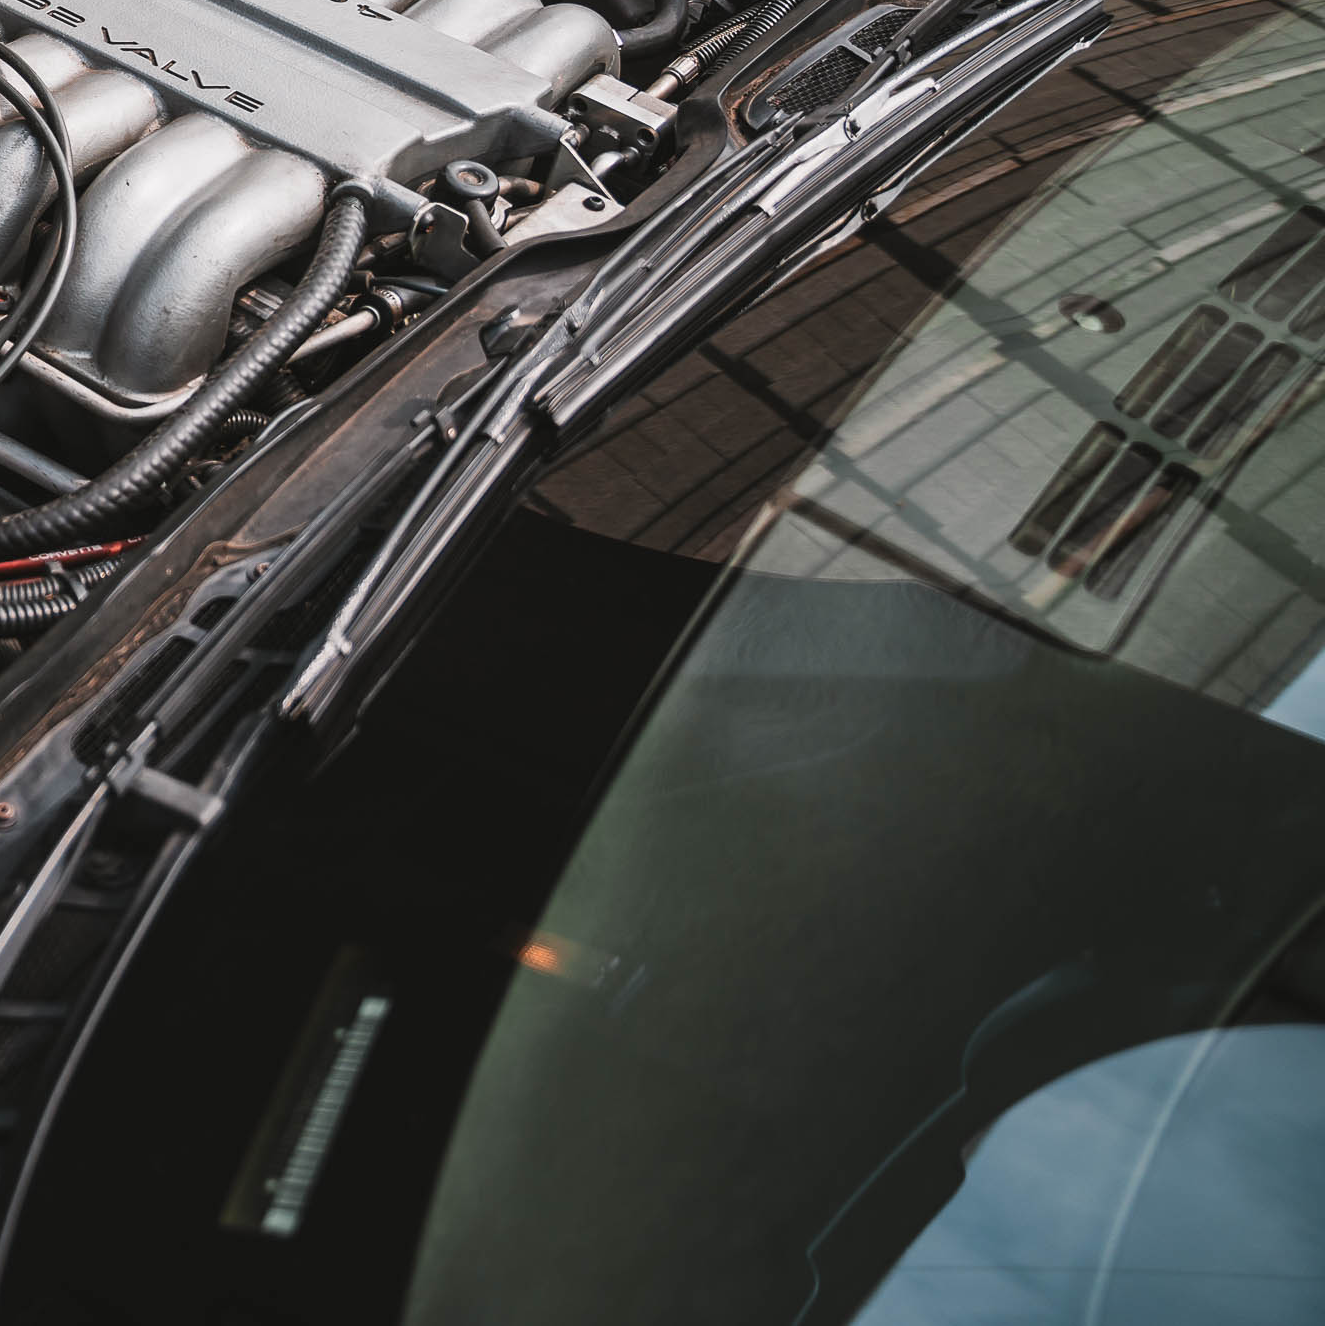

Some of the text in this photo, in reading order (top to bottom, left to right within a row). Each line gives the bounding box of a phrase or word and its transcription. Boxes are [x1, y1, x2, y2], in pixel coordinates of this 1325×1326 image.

[357, 3, 393, 22] 4
[100, 26, 265, 113] VALVE
[29, 544, 103, 561] CORVETTE
